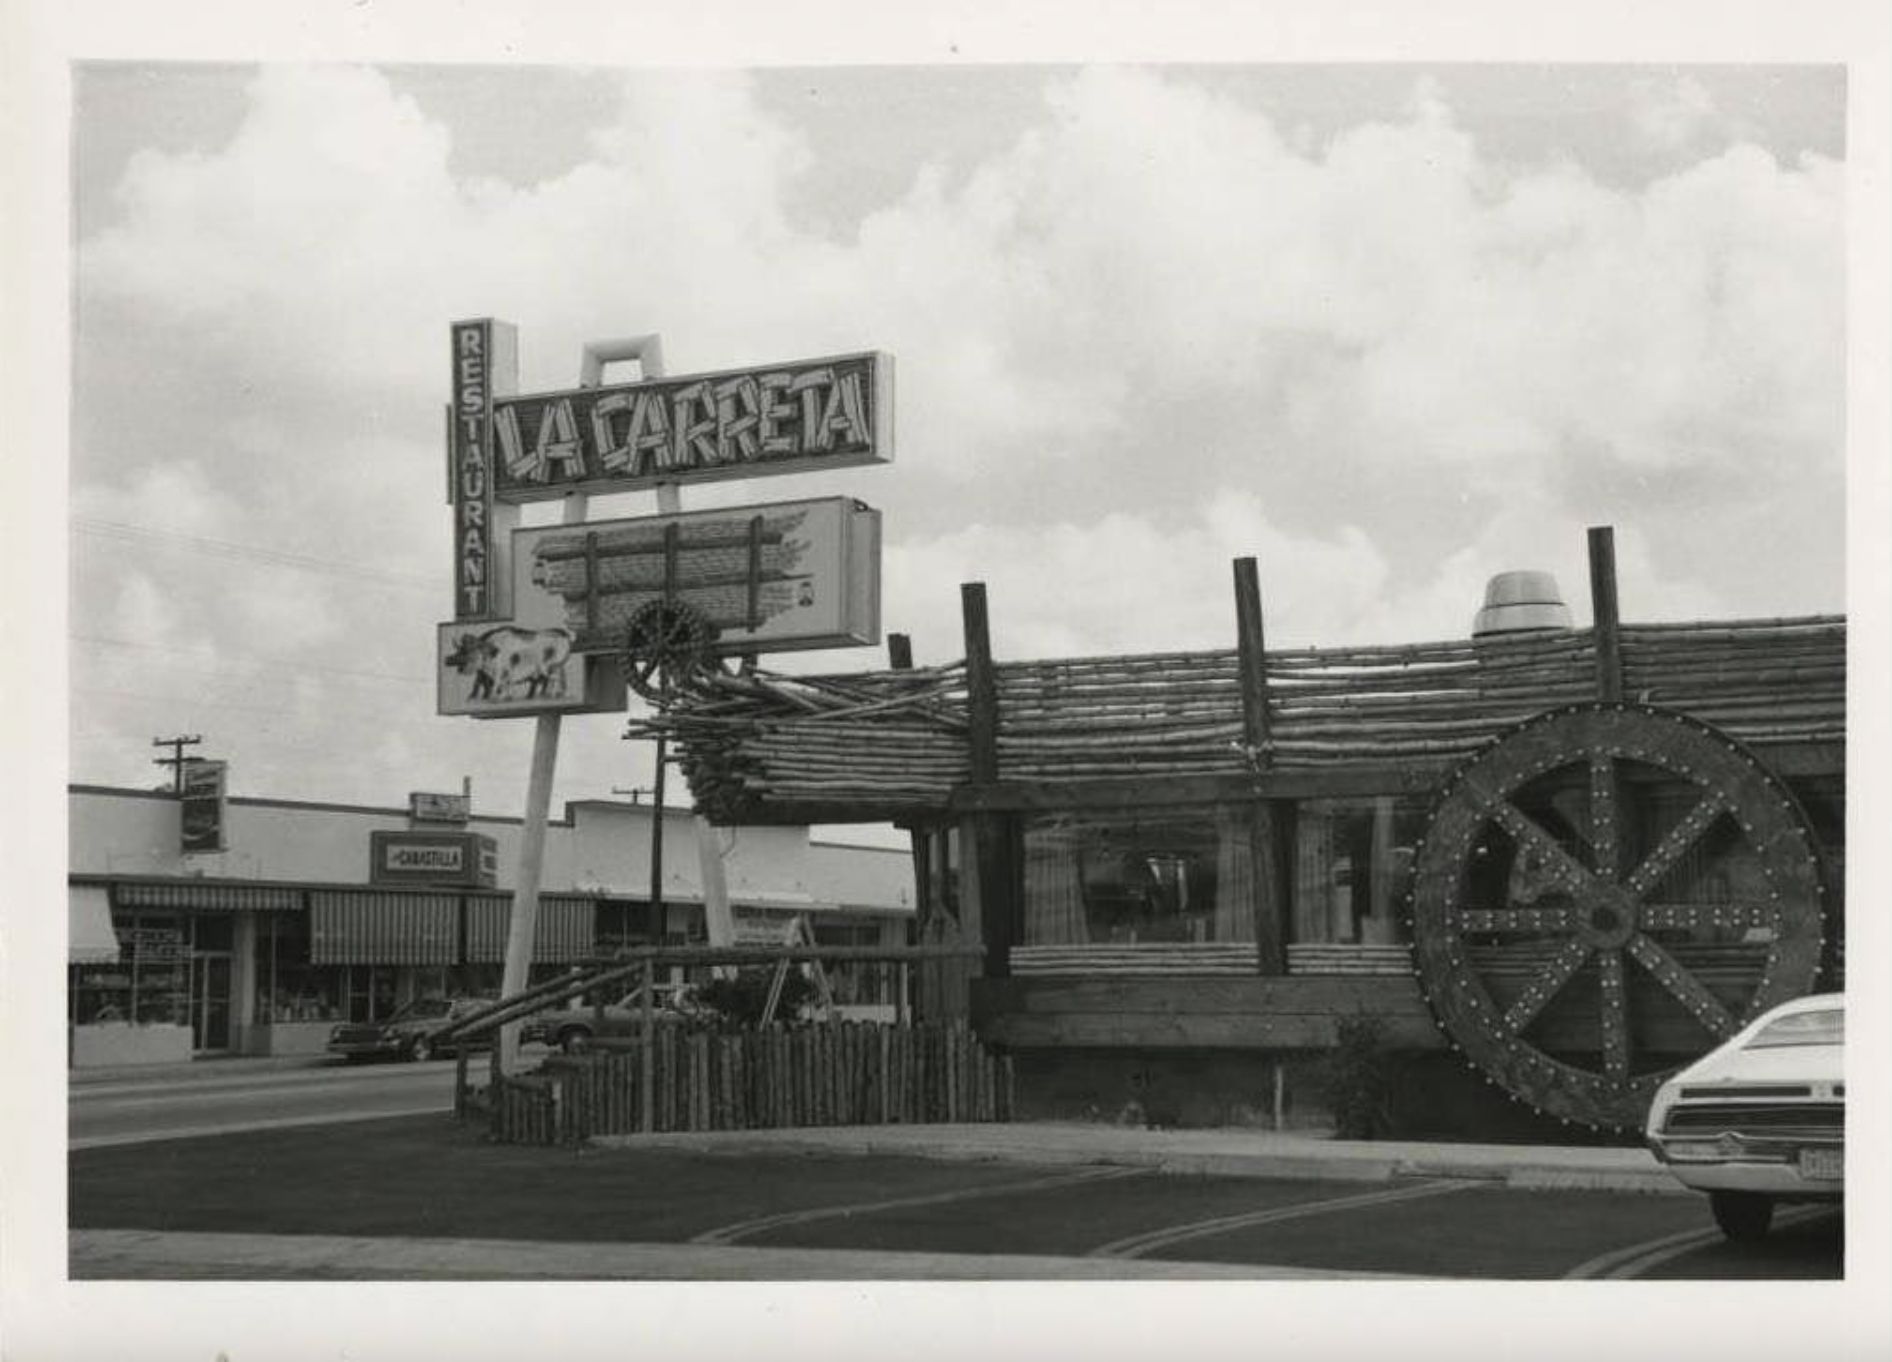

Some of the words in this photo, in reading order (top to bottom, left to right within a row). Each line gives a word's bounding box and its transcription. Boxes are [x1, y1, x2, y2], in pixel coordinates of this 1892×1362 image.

[459, 329, 485, 613] RESTAURANT
[494, 399, 587, 483] LA
[592, 367, 871, 475] CARRETA
